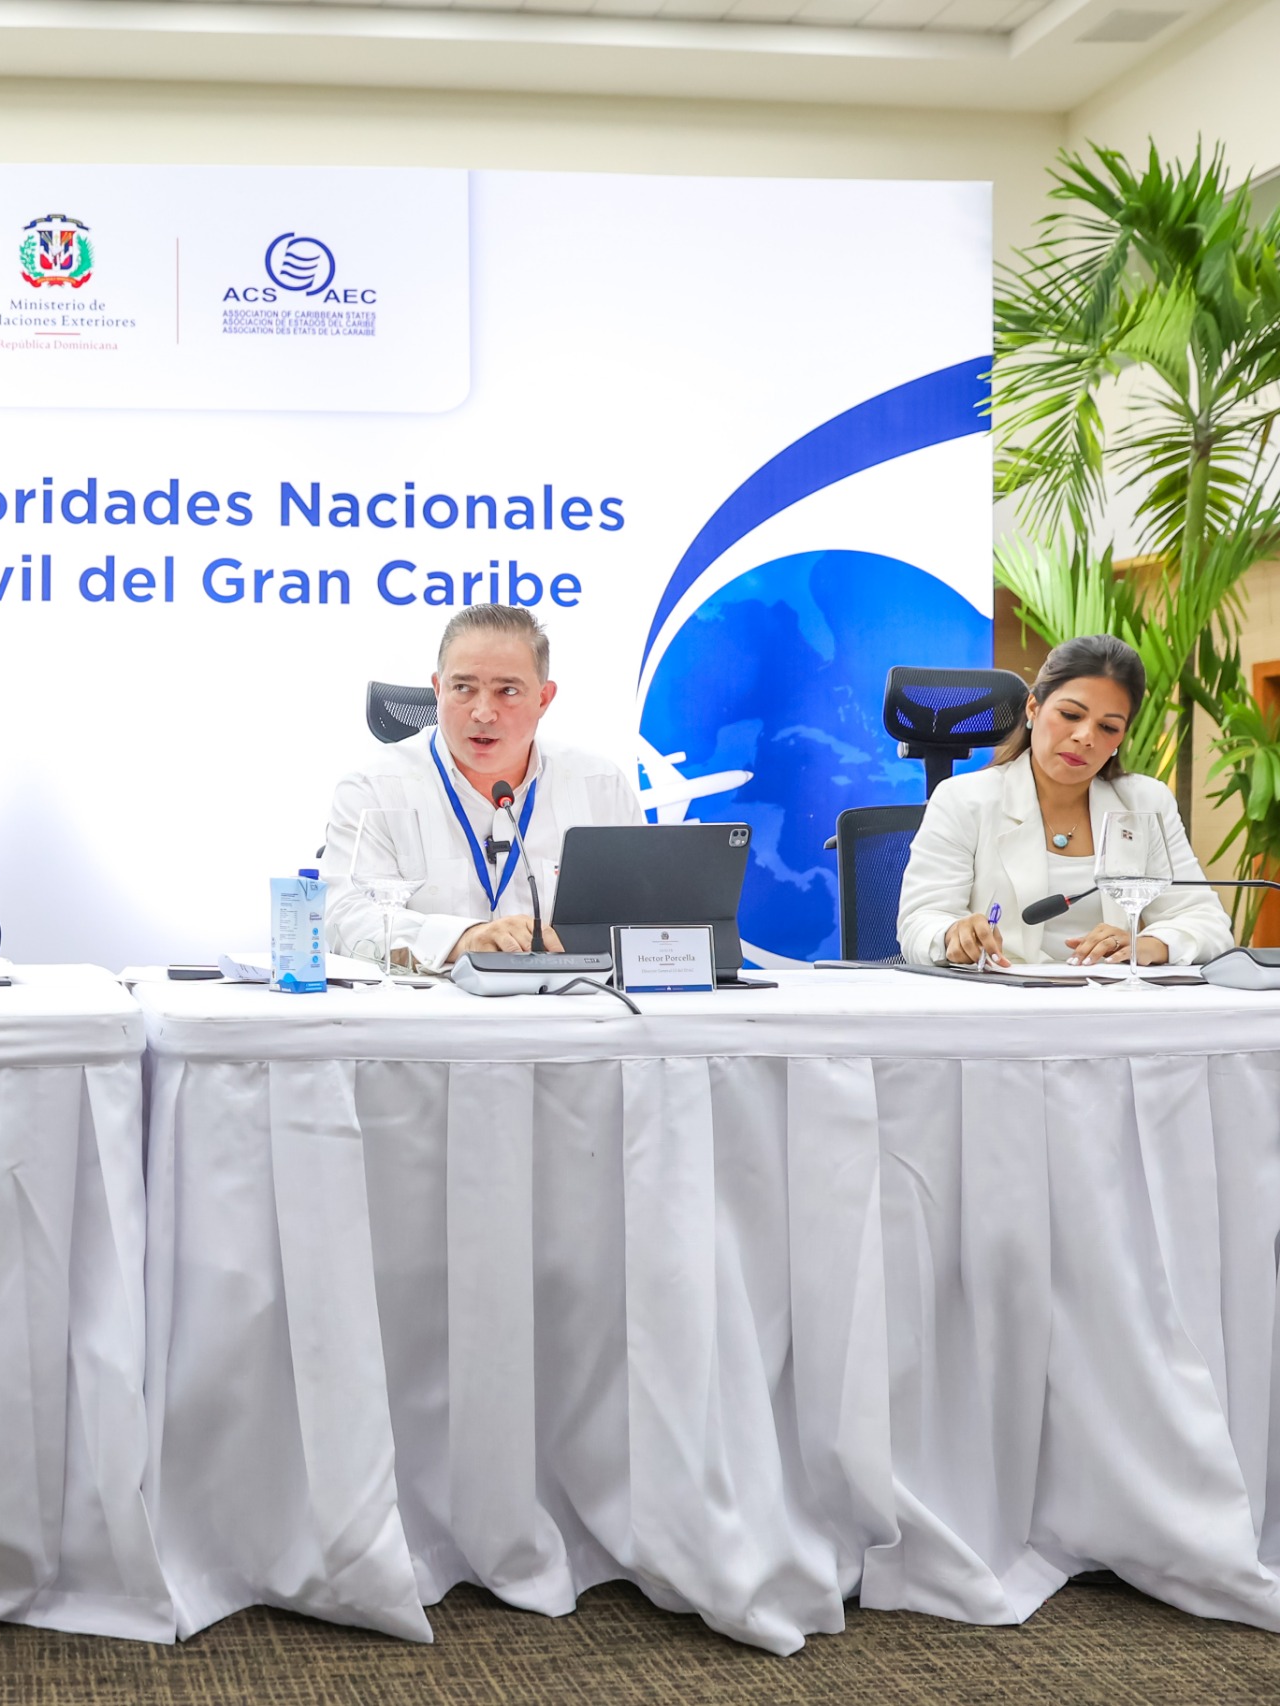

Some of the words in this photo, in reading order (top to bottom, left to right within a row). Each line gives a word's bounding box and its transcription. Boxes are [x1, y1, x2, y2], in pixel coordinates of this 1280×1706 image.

[222, 287, 277, 303] ACS
[323, 288, 377, 304] AEC
[9, 299, 86, 311] Ministerio
[89, 299, 106, 311] de
[222, 309, 278, 318] ASSOCIATION
[281, 310, 292, 318] OF
[294, 311, 343, 319] CARIBBEAN
[345, 311, 376, 320] STATES
[61, 315, 136, 327] Exteriores
[288, 319, 326, 327] ESTADOS
[328, 319, 343, 327] DEL
[345, 320, 375, 328] CARIBE
[222, 326, 273, 334] ASSOCIATION
[276, 327, 291, 335] DES
[330, 328, 340, 336] LA
[53, 340, 118, 350] Dominicana
[280, 481, 625, 532] Nacionales
[78, 555, 175, 602] del
[202, 558, 351, 604] Gran
[377, 559, 582, 607] Caribe
[664, 954, 696, 962] Porcella
